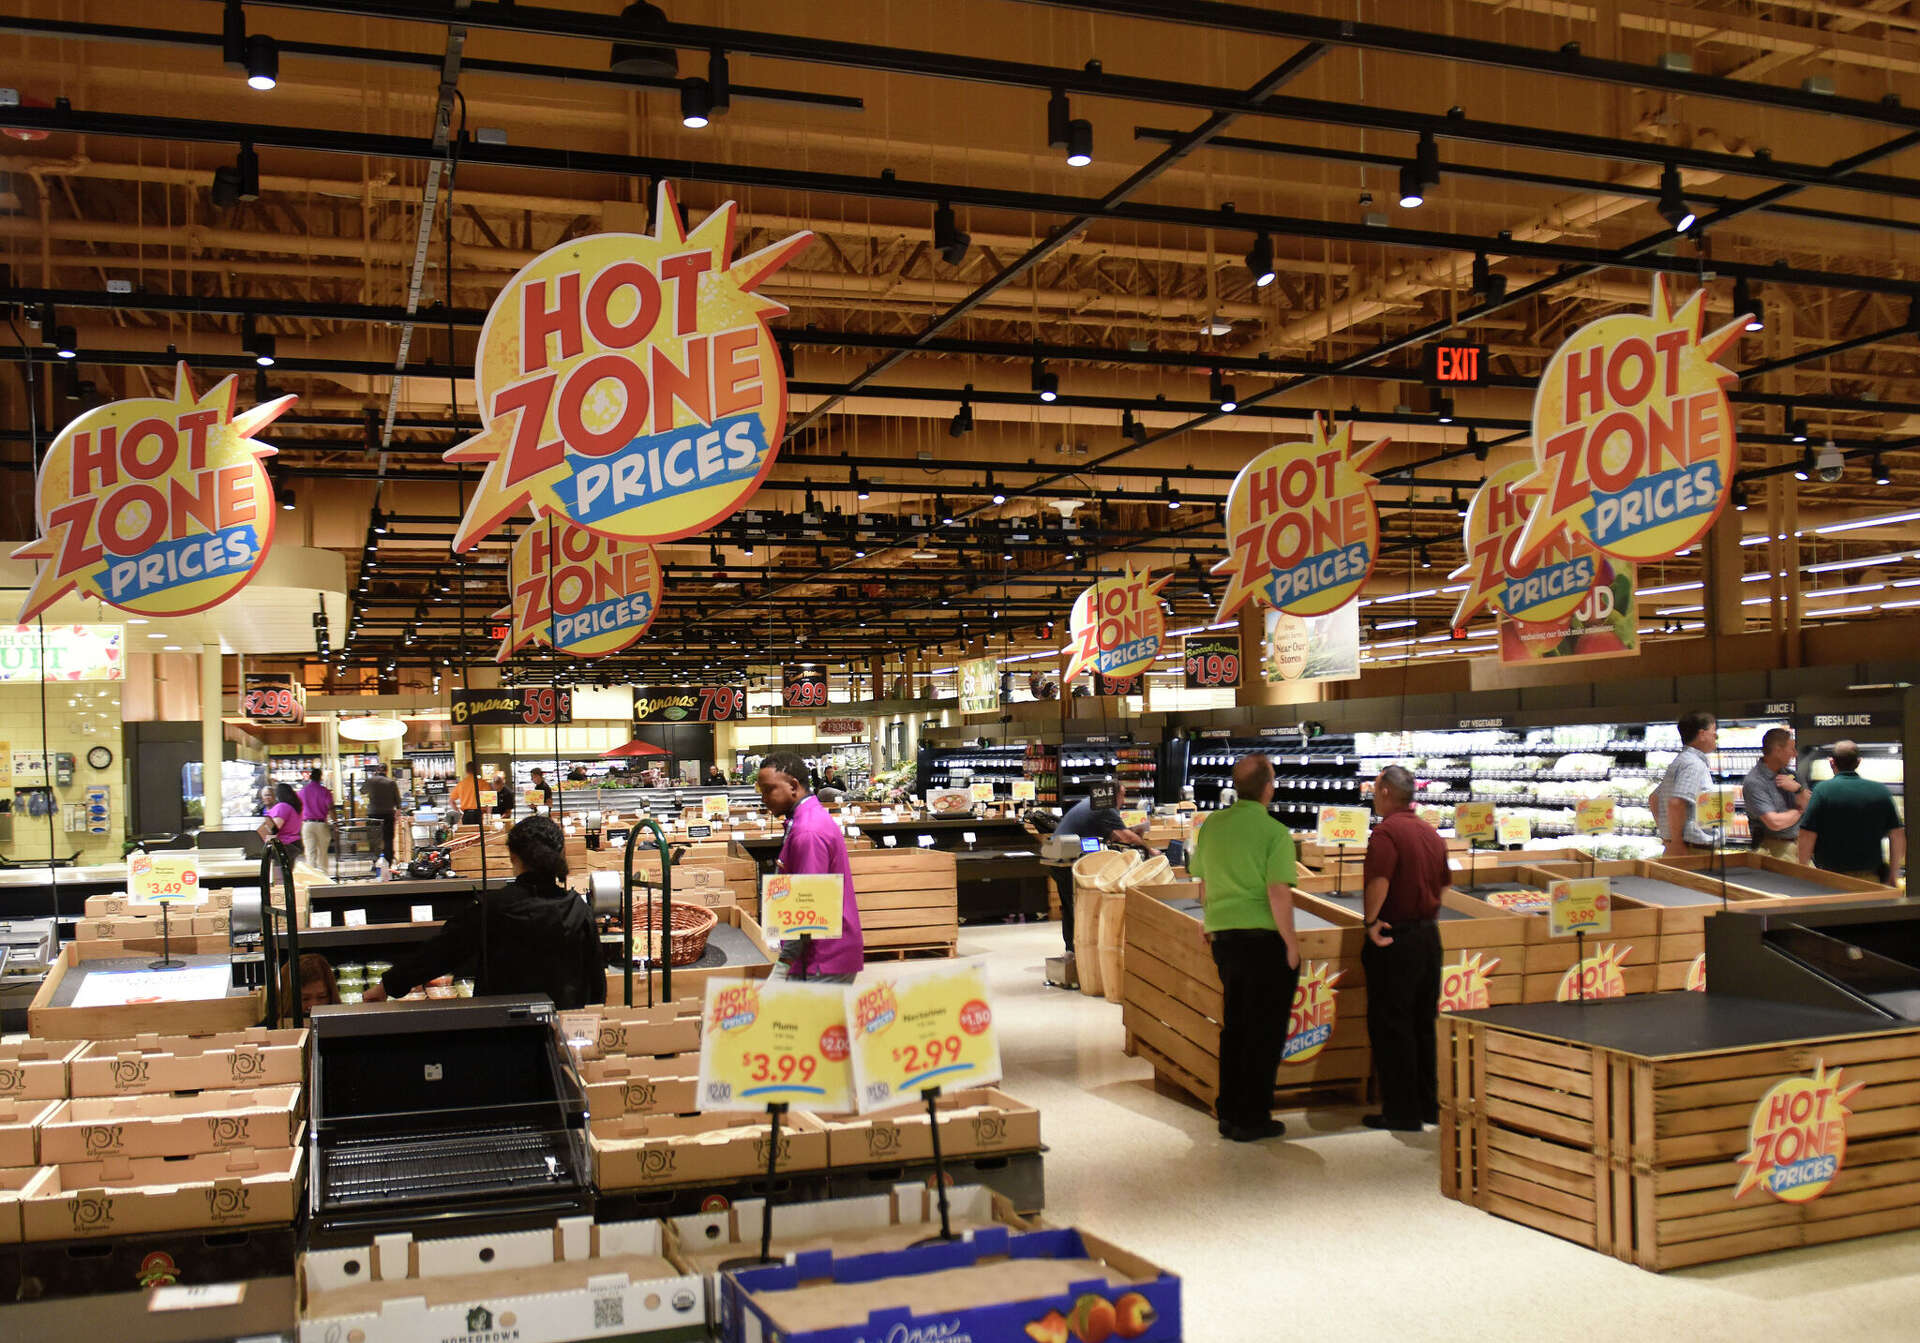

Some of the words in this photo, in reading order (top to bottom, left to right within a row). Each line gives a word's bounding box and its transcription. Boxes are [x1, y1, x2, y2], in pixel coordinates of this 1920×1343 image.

[523, 250, 712, 375] HOT
[1437, 346, 1480, 381] EXIT
[1565, 330, 1689, 425] HOT
[494, 326, 763, 489] ZONE
[72, 410, 218, 498] HOT
[577, 421, 758, 516] PRICES
[1545, 392, 1721, 516] ZONE
[1250, 450, 1341, 524] HOT
[1597, 466, 1716, 540] PRICES
[50, 464, 257, 578] ZONE
[1236, 493, 1368, 588] ZONE
[111, 530, 251, 597] PRICES
[1276, 547, 1366, 603] PRICES
[517, 549, 650, 631] ZONE
[1087, 583, 1143, 624] HOT
[1508, 560, 1591, 611] PRICES
[556, 596, 647, 643] PRICES
[1078, 607, 1159, 661] ZONE
[1101, 638, 1159, 671] PRICES
[634, 695, 698, 719] Bananas
[827, 722, 857, 732] FLORAL
[1459, 719, 1471, 728] CUT
[1472, 718, 1503, 728] VEGETABLES
[1767, 704, 1789, 714] JUICE
[1815, 715, 1844, 727] FRESH
[1846, 714, 1871, 726] JUICE
[147, 882, 182, 894] $3.49
[720, 986, 748, 1004] HOT
[858, 988, 884, 1011] HOT
[1291, 980, 1321, 1010] OT
[1444, 969, 1475, 997] OT
[1568, 960, 1610, 1000] HOT
[773, 1022, 799, 1031] Plums
[1287, 1000, 1333, 1041] ONE
[892, 1035, 962, 1073] $2.99
[1282, 1026, 1330, 1059] PRICES
[743, 1053, 818, 1083] $3.99
[1768, 1089, 1832, 1131] HOT
[1755, 1120, 1841, 1175] ZONE
[1775, 1159, 1835, 1189] PRICES
